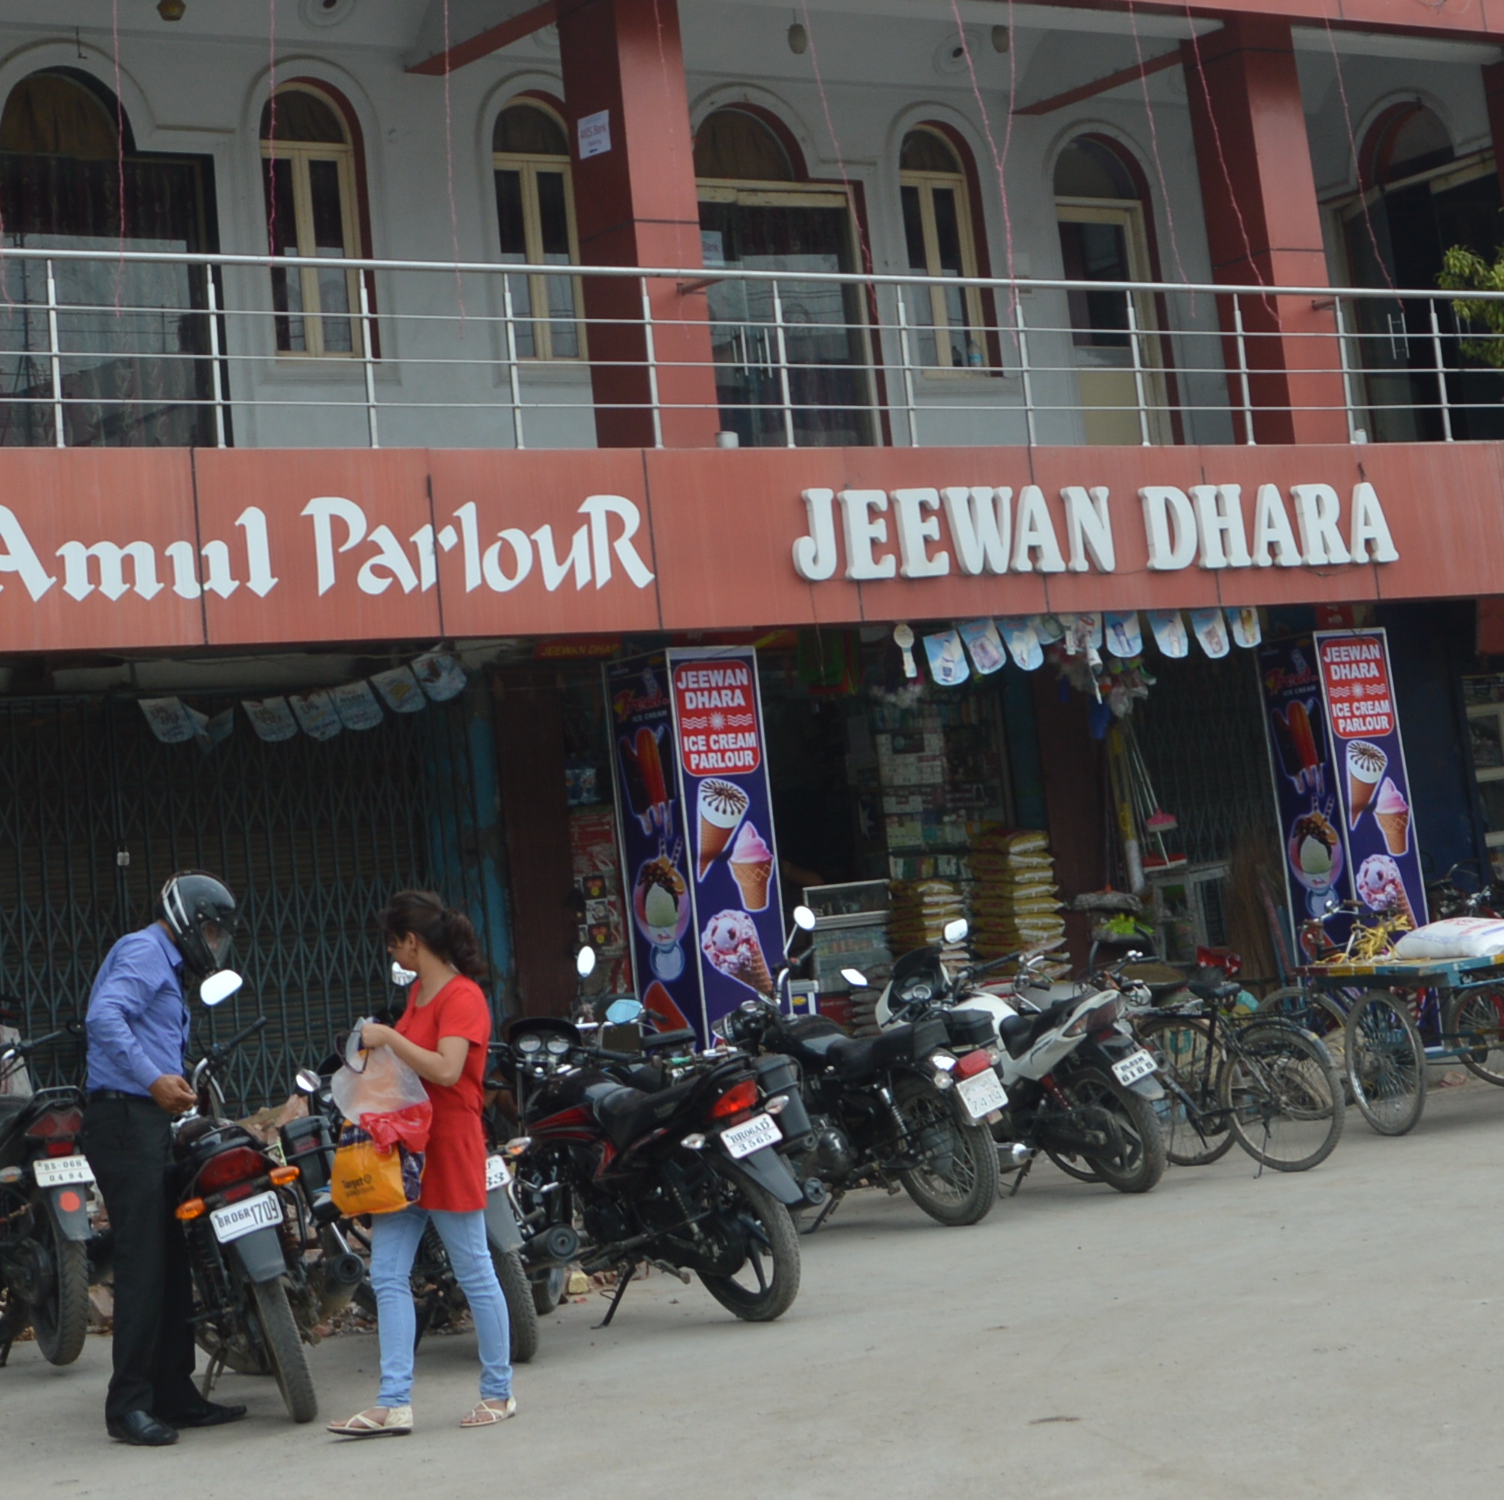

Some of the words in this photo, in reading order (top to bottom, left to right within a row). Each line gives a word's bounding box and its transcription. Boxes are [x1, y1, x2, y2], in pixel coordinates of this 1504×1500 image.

[792, 485, 1116, 582] JEEWAN
[1138, 482, 1400, 571] DHARA
[1323, 644, 1381, 663] JEEWAN
[677, 668, 748, 690] JEEWAN
[1330, 662, 1380, 681] DHARA
[685, 689, 746, 710] DHARA
[1332, 703, 1352, 717] ICE
[1352, 699, 1391, 717] CREAM
[1338, 715, 1390, 733] PARLOUR
[684, 735, 707, 752] ICE
[709, 732, 756, 750] CREAM
[690, 750, 755, 770] PARLOUR
[739, 1132, 772, 1153] 3565
